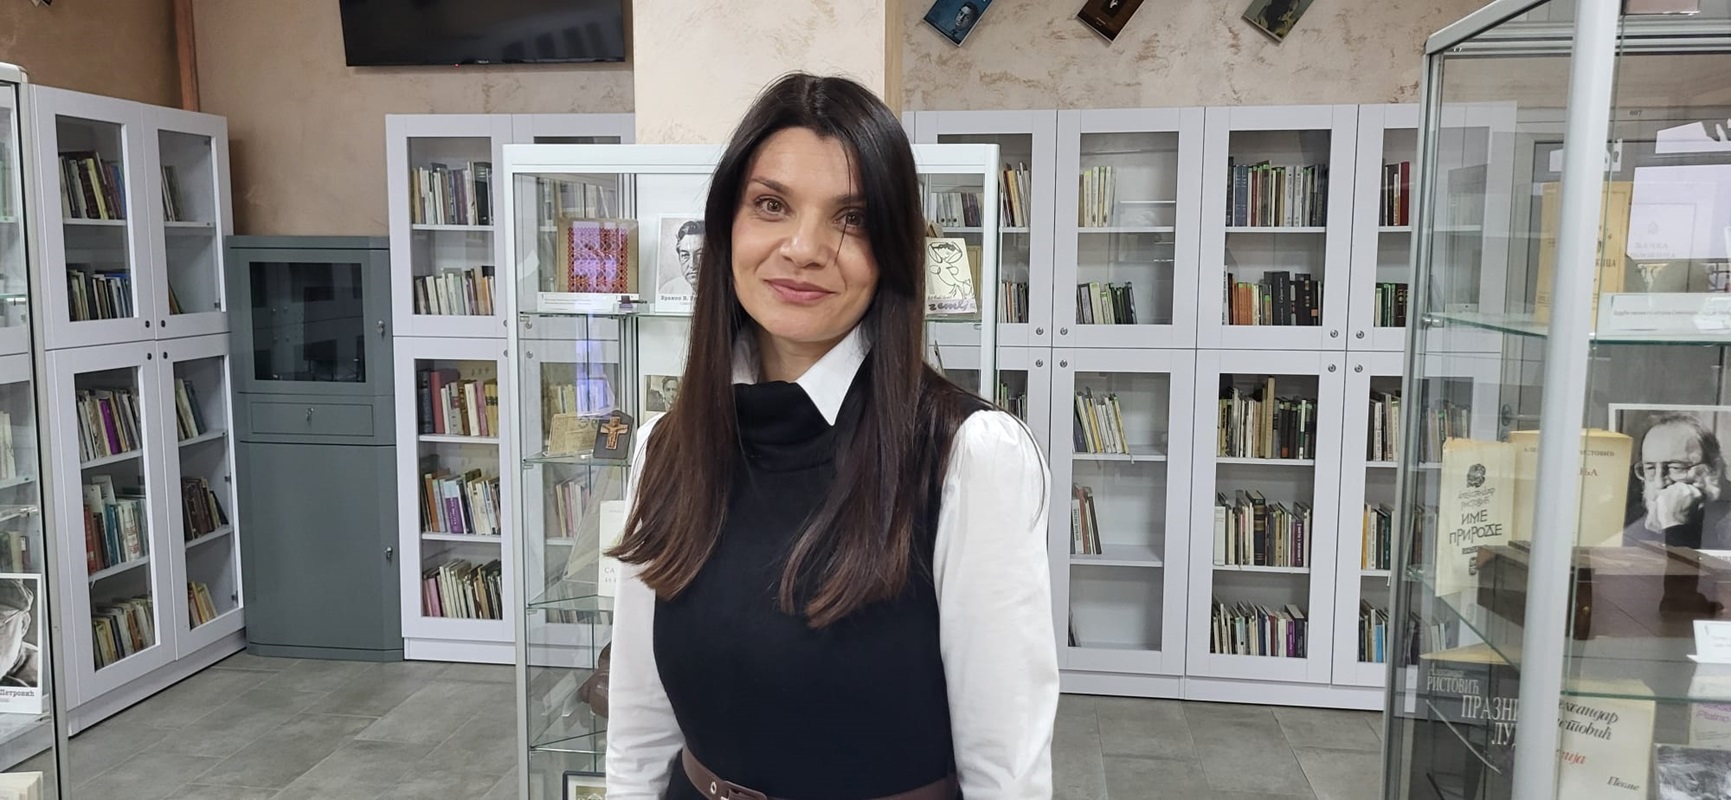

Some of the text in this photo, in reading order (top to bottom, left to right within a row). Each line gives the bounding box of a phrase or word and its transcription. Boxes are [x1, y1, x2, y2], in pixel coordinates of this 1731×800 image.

[1579, 467, 1599, 477] ЊА
[1461, 509, 1488, 525] ИМЕ
[1449, 523, 1503, 547] ПРИРОДЕ
[1426, 676, 1480, 695] РИСТОВИЋ
[1559, 700, 1619, 725] ександар
[1491, 721, 1517, 750] ЛУ
[1557, 718, 1613, 741] стовић
[1556, 749, 1586, 765] ија
